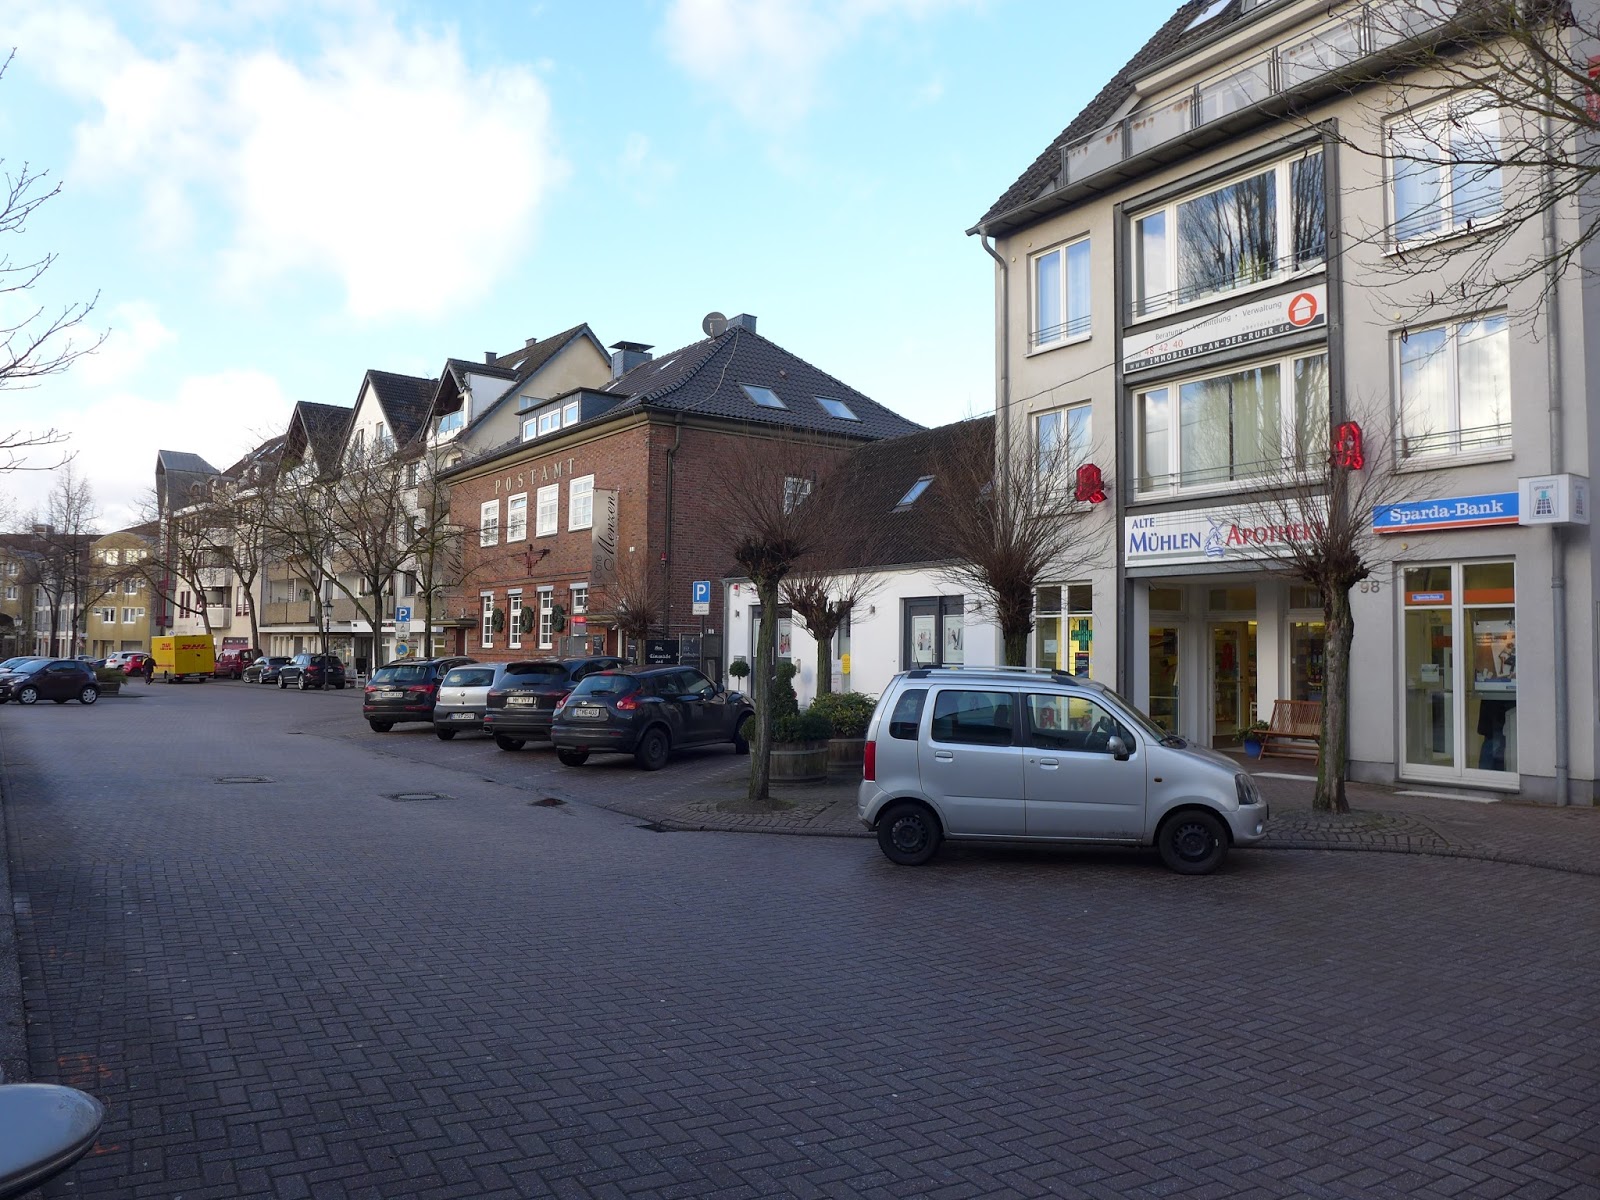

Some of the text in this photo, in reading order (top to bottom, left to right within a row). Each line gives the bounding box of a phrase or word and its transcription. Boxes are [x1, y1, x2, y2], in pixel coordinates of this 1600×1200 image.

[1155, 301, 1282, 341] Beratung Vermittlung Verwaltung
[1158, 343, 1169, 352] 42
[1172, 339, 1184, 348] 40
[495, 457, 575, 494] POSTAMT
[1132, 517, 1155, 530] ALTE
[1389, 500, 1504, 524] Sparda-Bank
[597, 494, 616, 572] Menzen
[1129, 531, 1202, 554] MÜHLEN
[1360, 581, 1381, 594] 98
